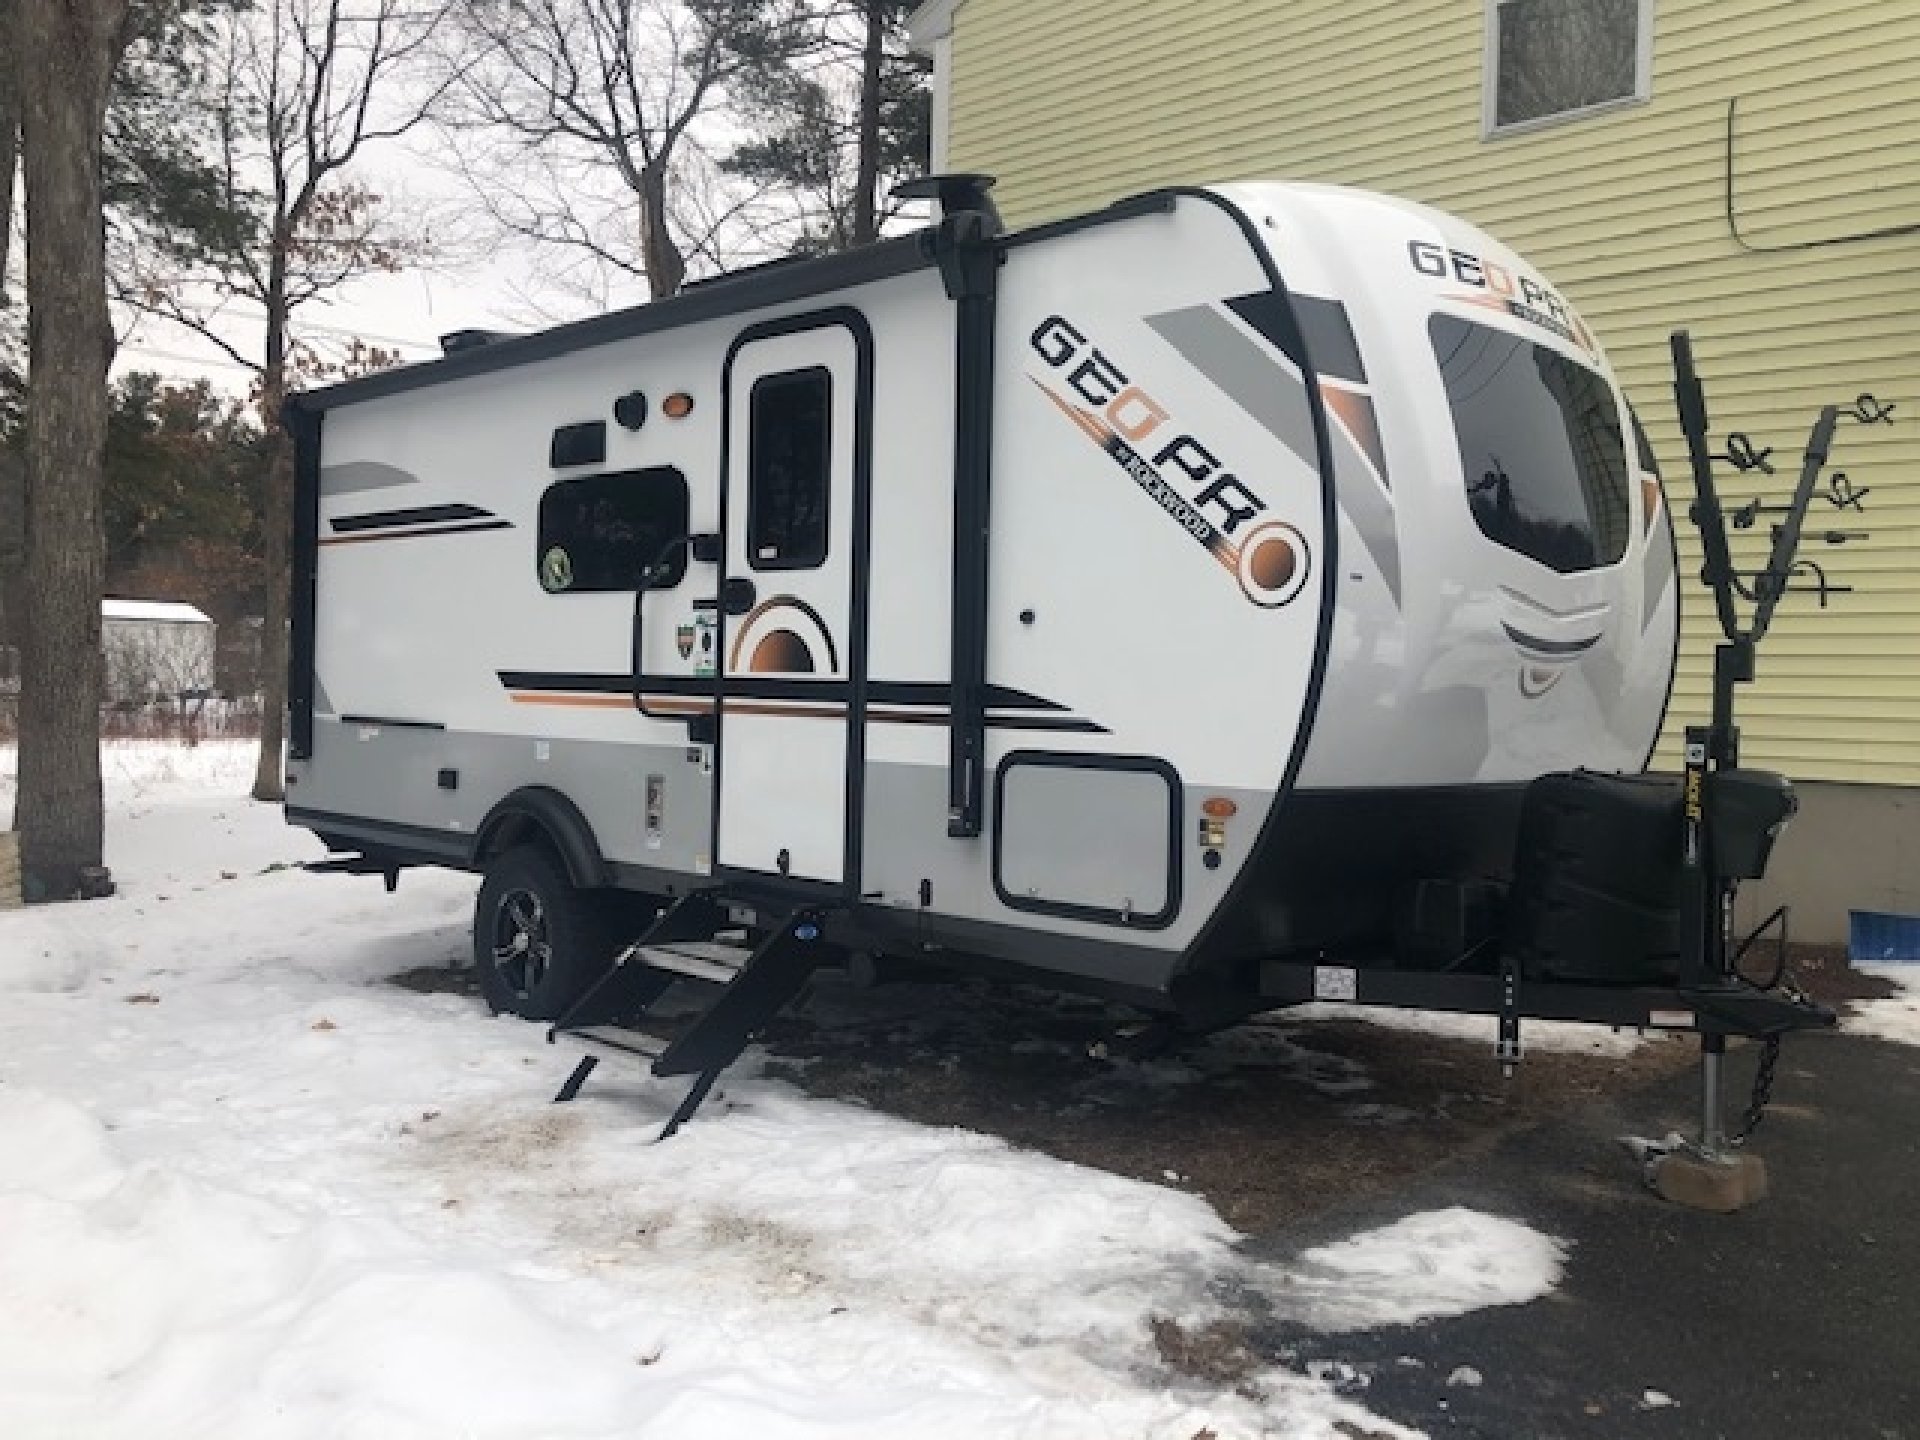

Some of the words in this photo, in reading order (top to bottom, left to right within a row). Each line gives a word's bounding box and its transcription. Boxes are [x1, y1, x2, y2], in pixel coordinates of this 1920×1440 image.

[1408, 240, 1514, 295] GEO
[1029, 315, 1170, 440] GEO
[1124, 454, 1213, 542] ROCKWOOD
